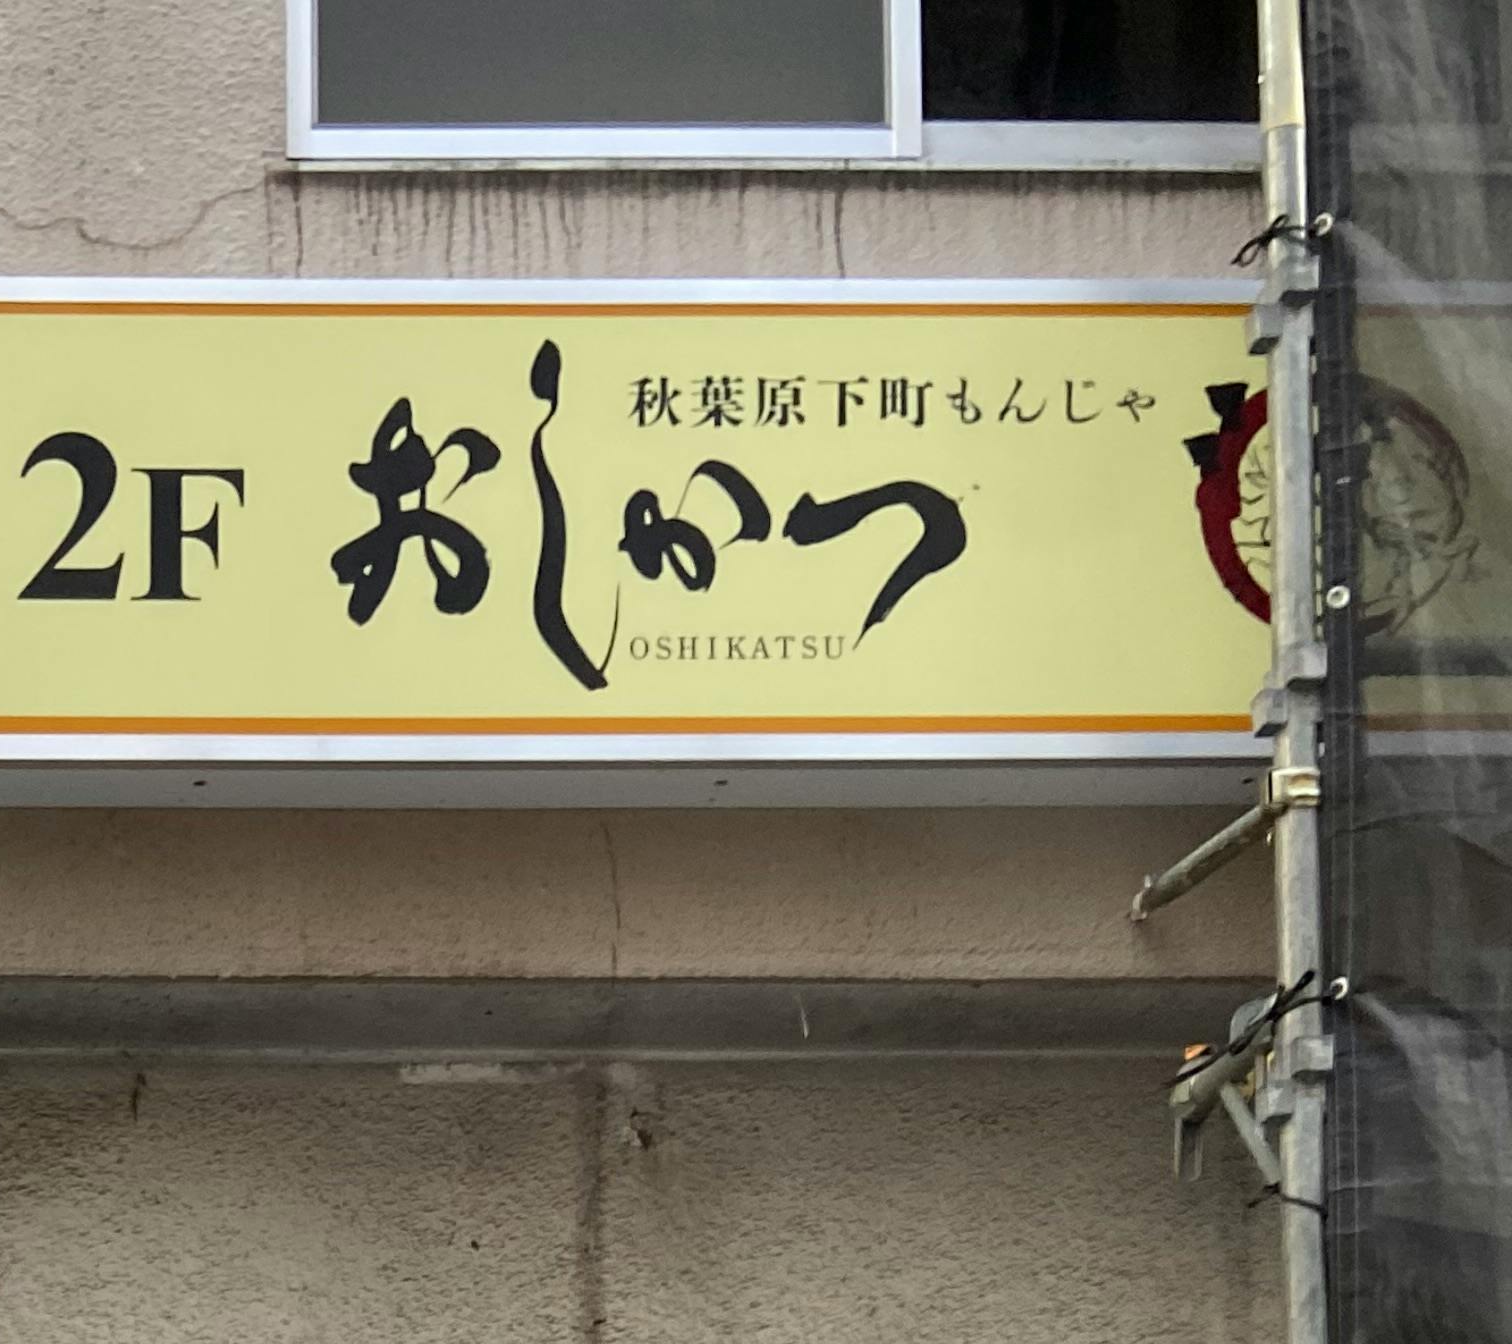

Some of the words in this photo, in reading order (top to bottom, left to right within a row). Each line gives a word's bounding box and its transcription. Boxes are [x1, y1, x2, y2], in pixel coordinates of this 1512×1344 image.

[630, 375, 1157, 428] 秋葉原下町もんじゃ
[17, 430, 246, 602] 2F
[330, 338, 968, 692] おしかつ
[629, 635, 847, 661] OSHIKATSU
